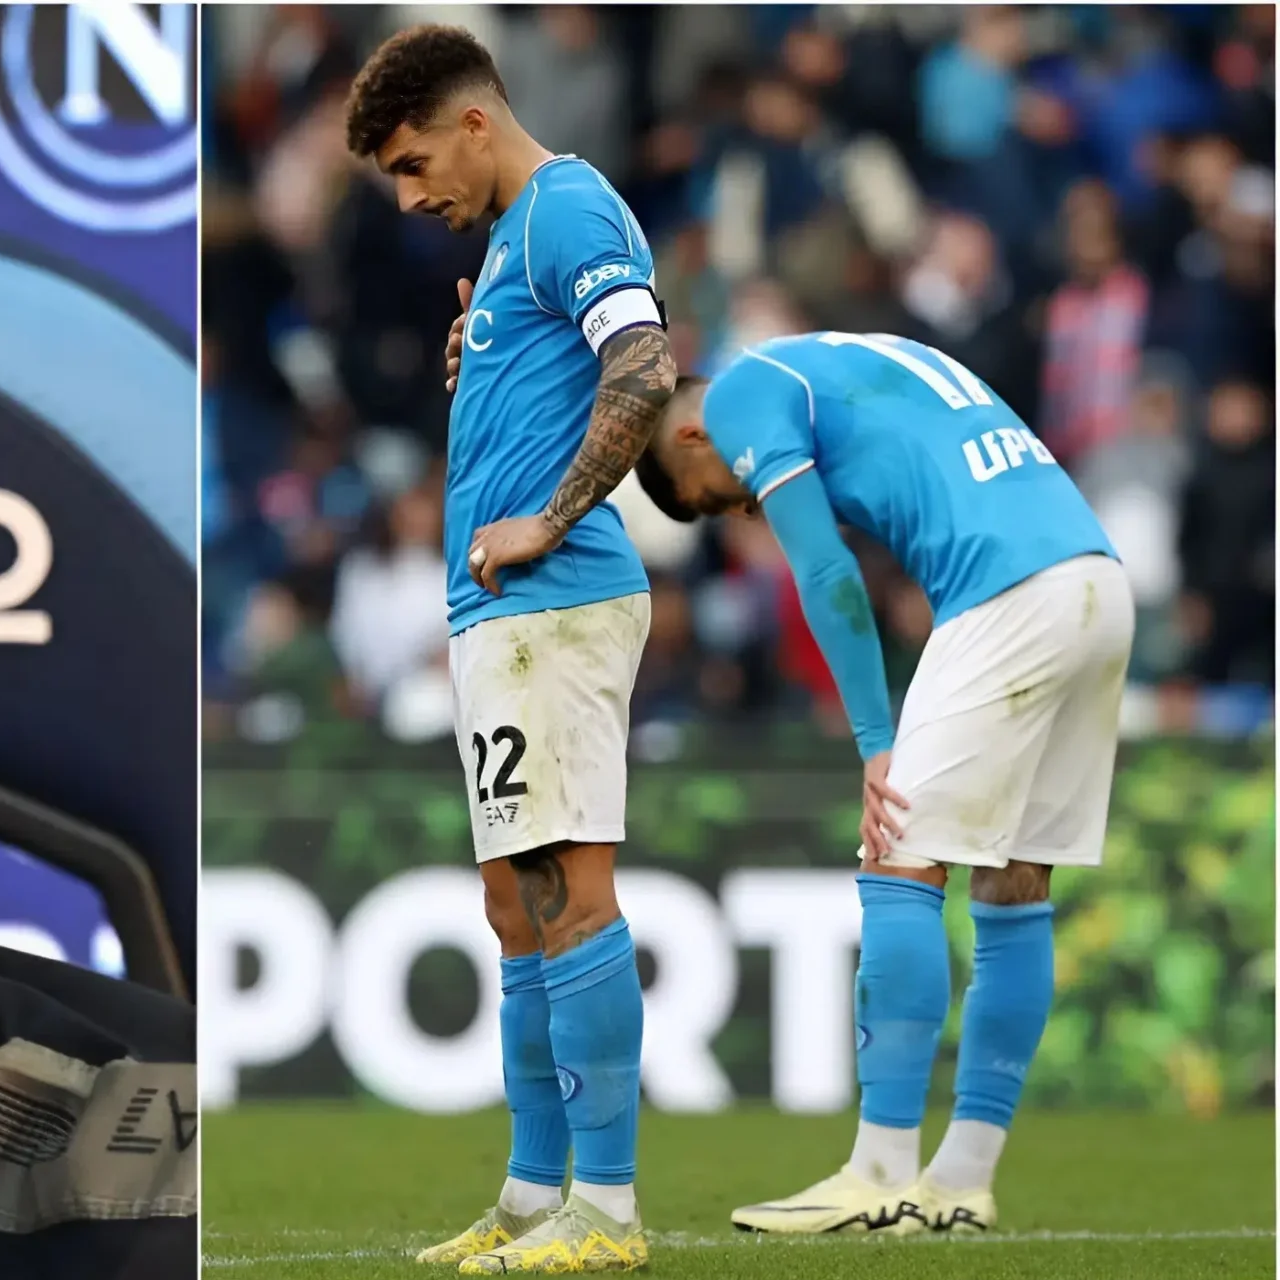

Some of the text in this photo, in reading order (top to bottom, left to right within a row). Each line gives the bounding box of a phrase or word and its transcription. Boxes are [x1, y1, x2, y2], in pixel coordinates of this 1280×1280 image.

[54, 3, 188, 126] N
[574, 262, 631, 299] ebay
[472, 725, 528, 804] 22
[201, 865, 866, 1115] PORT
